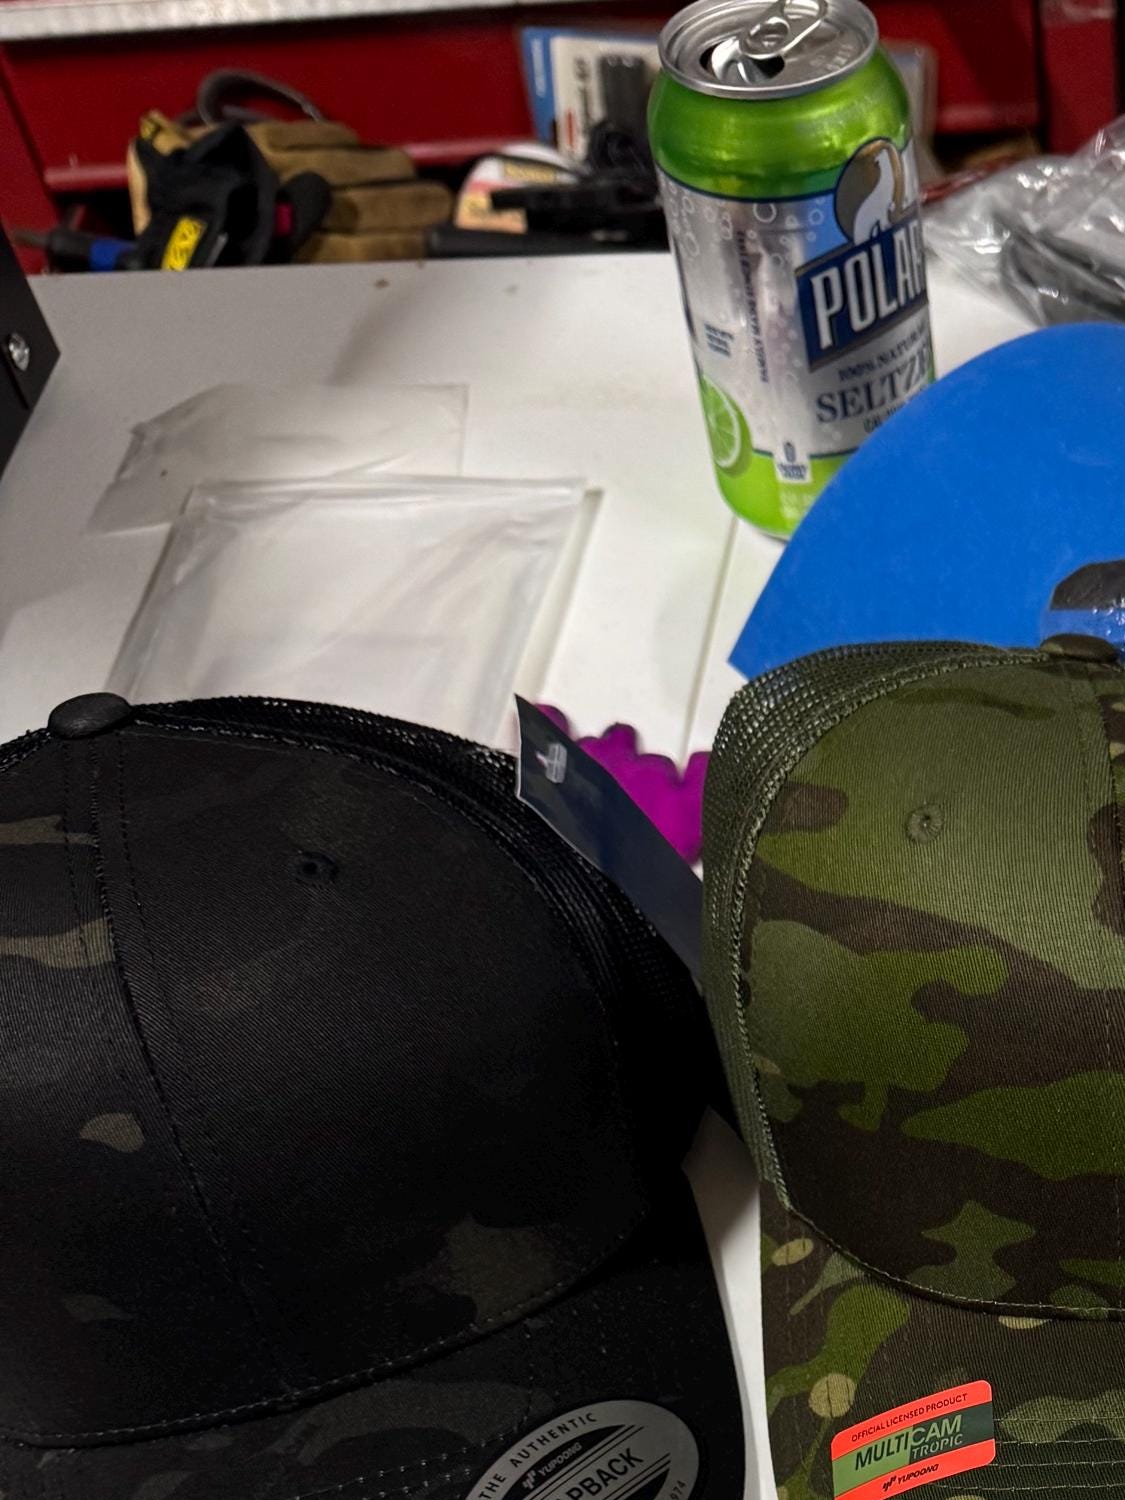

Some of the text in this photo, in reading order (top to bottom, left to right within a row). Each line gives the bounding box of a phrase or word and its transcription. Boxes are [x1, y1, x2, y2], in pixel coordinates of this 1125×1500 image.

[815, 345, 928, 423] SELTZE
[852, 1393, 968, 1442] OFFICIAL LICENSED PRODUCT
[478, 1412, 598, 1500] THE AUTHENTIC
[538, 1442, 582, 1477] YUPOONG
[855, 1414, 962, 1471] MULTICAM
[912, 1433, 963, 1460] TROPIC
[898, 1463, 940, 1485] YUPOONG
